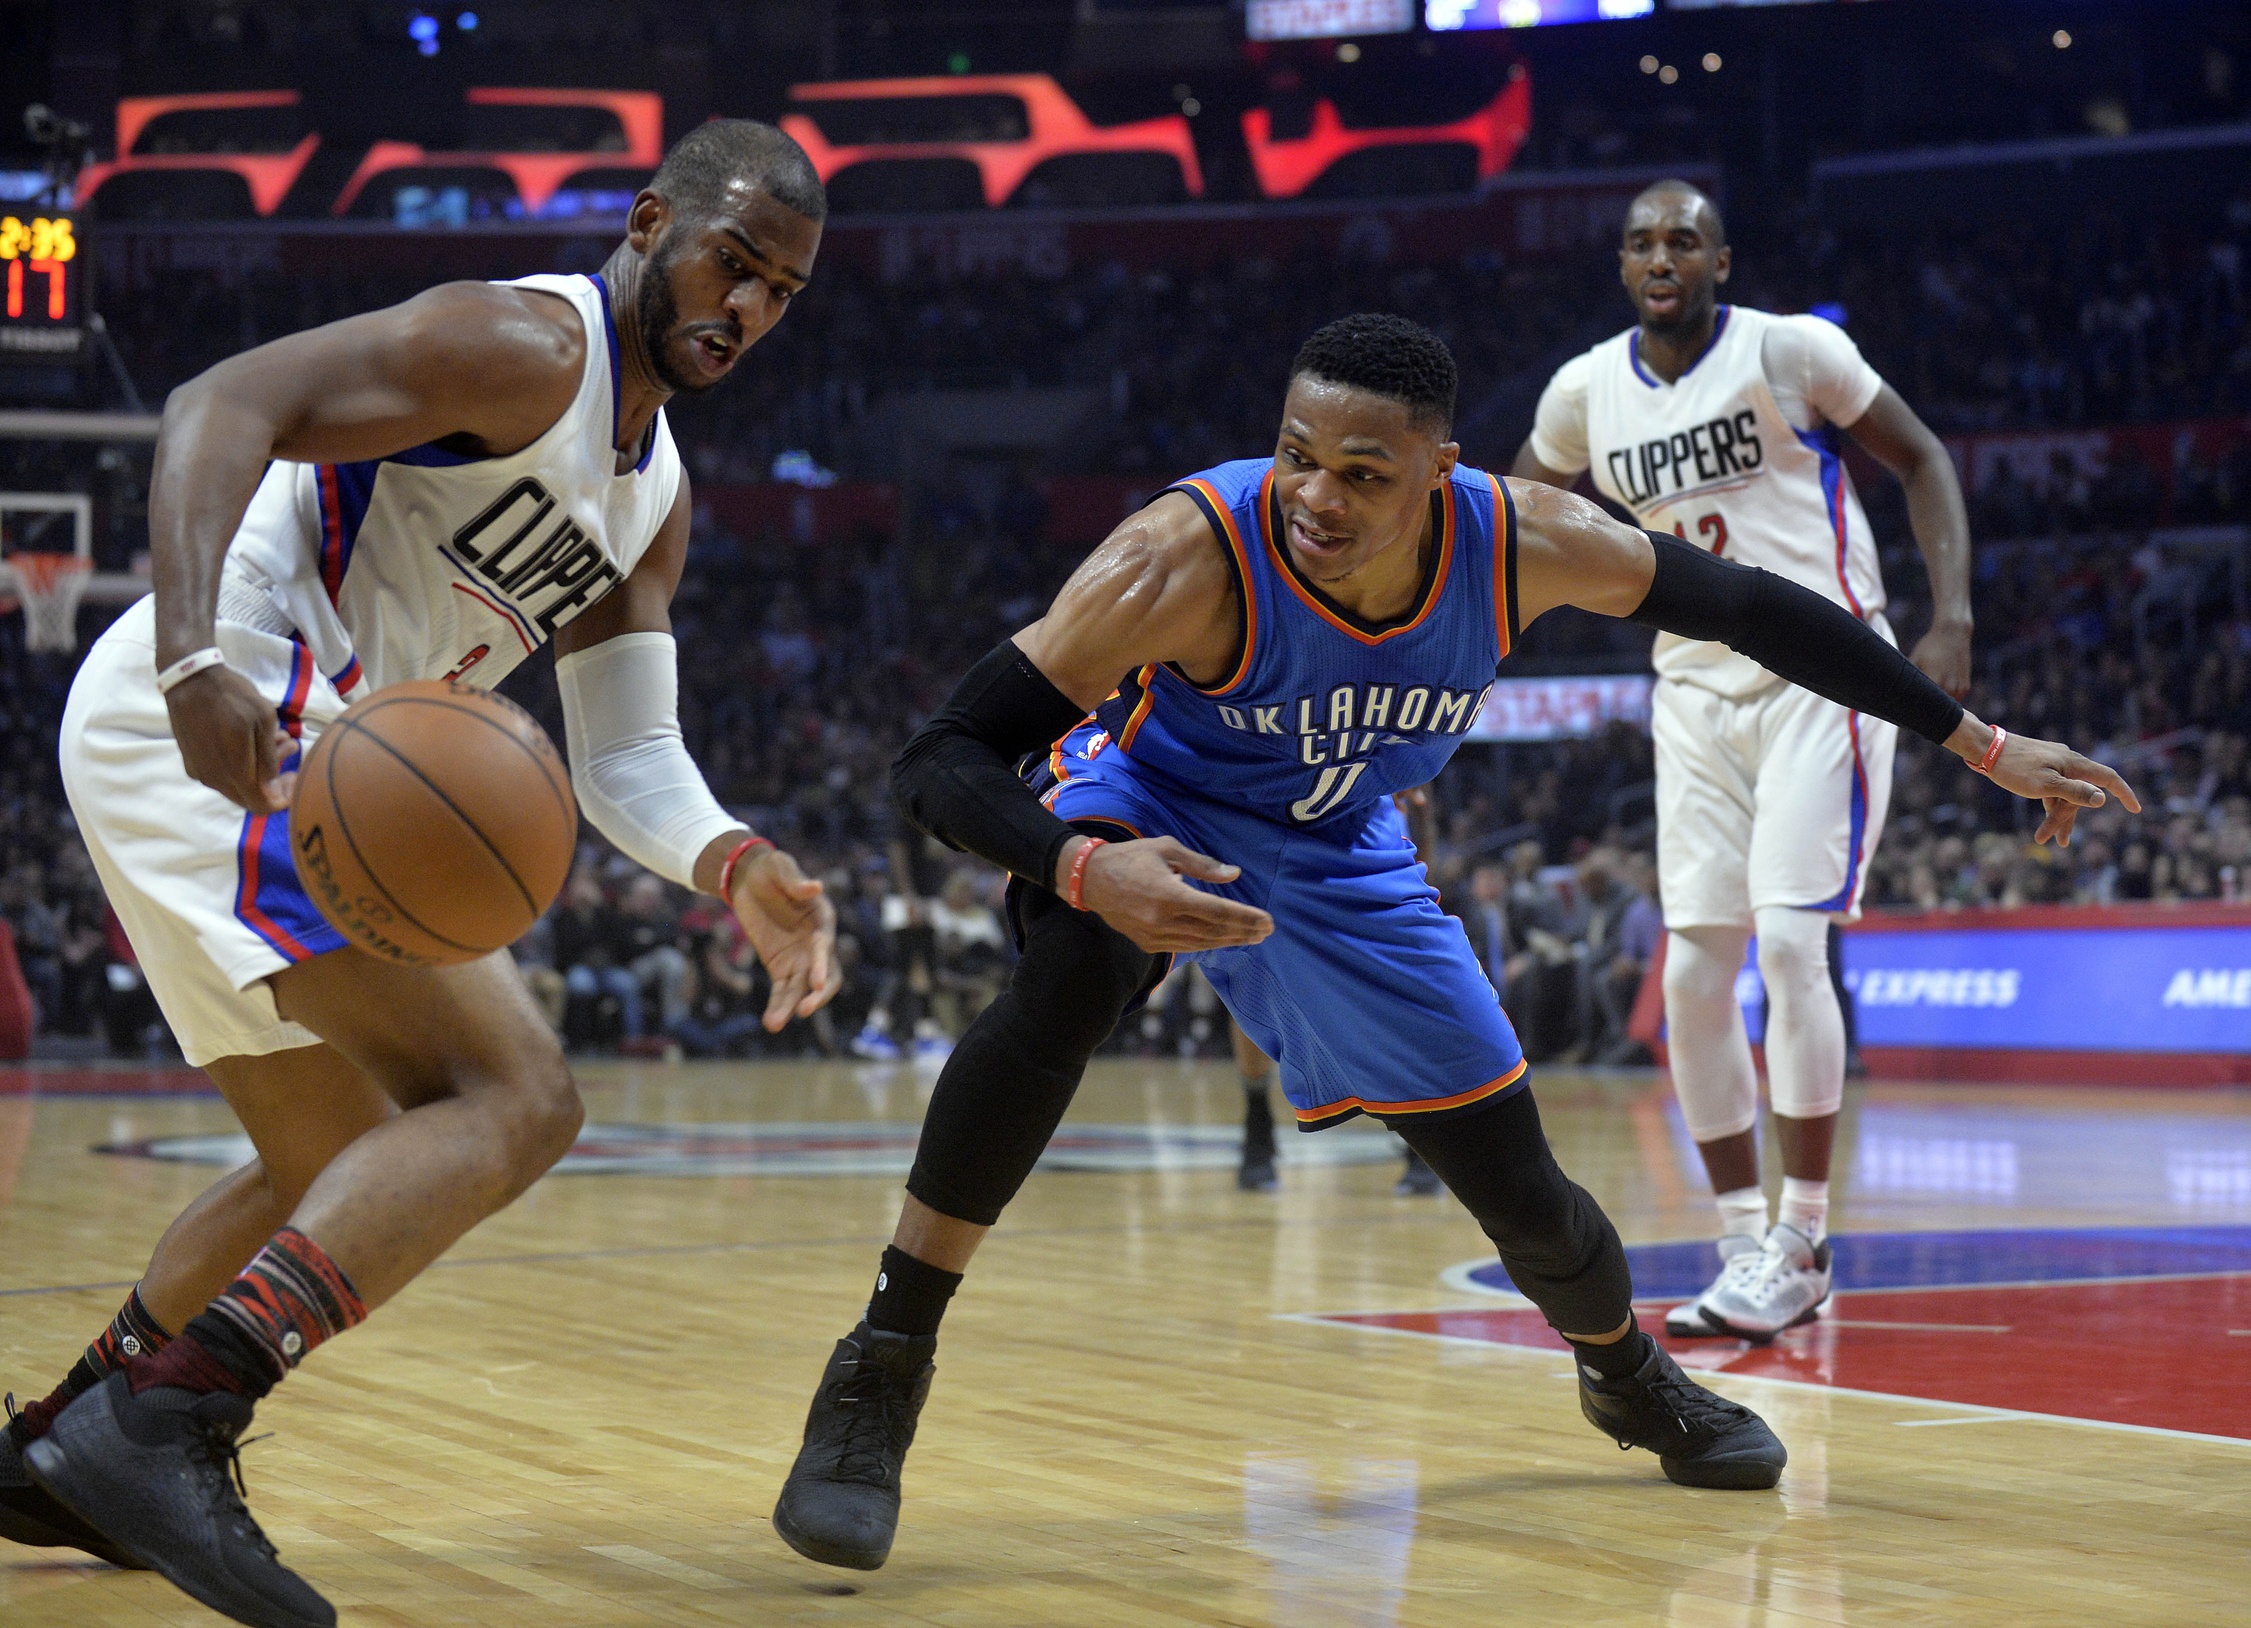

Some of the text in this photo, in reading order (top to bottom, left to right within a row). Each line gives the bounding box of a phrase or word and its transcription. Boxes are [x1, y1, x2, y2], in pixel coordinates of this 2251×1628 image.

[7, 258, 66, 320] 17
[1608, 409, 1763, 506] CLIPPERS
[453, 475, 624, 638] CLIPPE
[1215, 683, 1494, 737] OKLAHOMA
[1859, 968, 2021, 1008] EXPRESS
